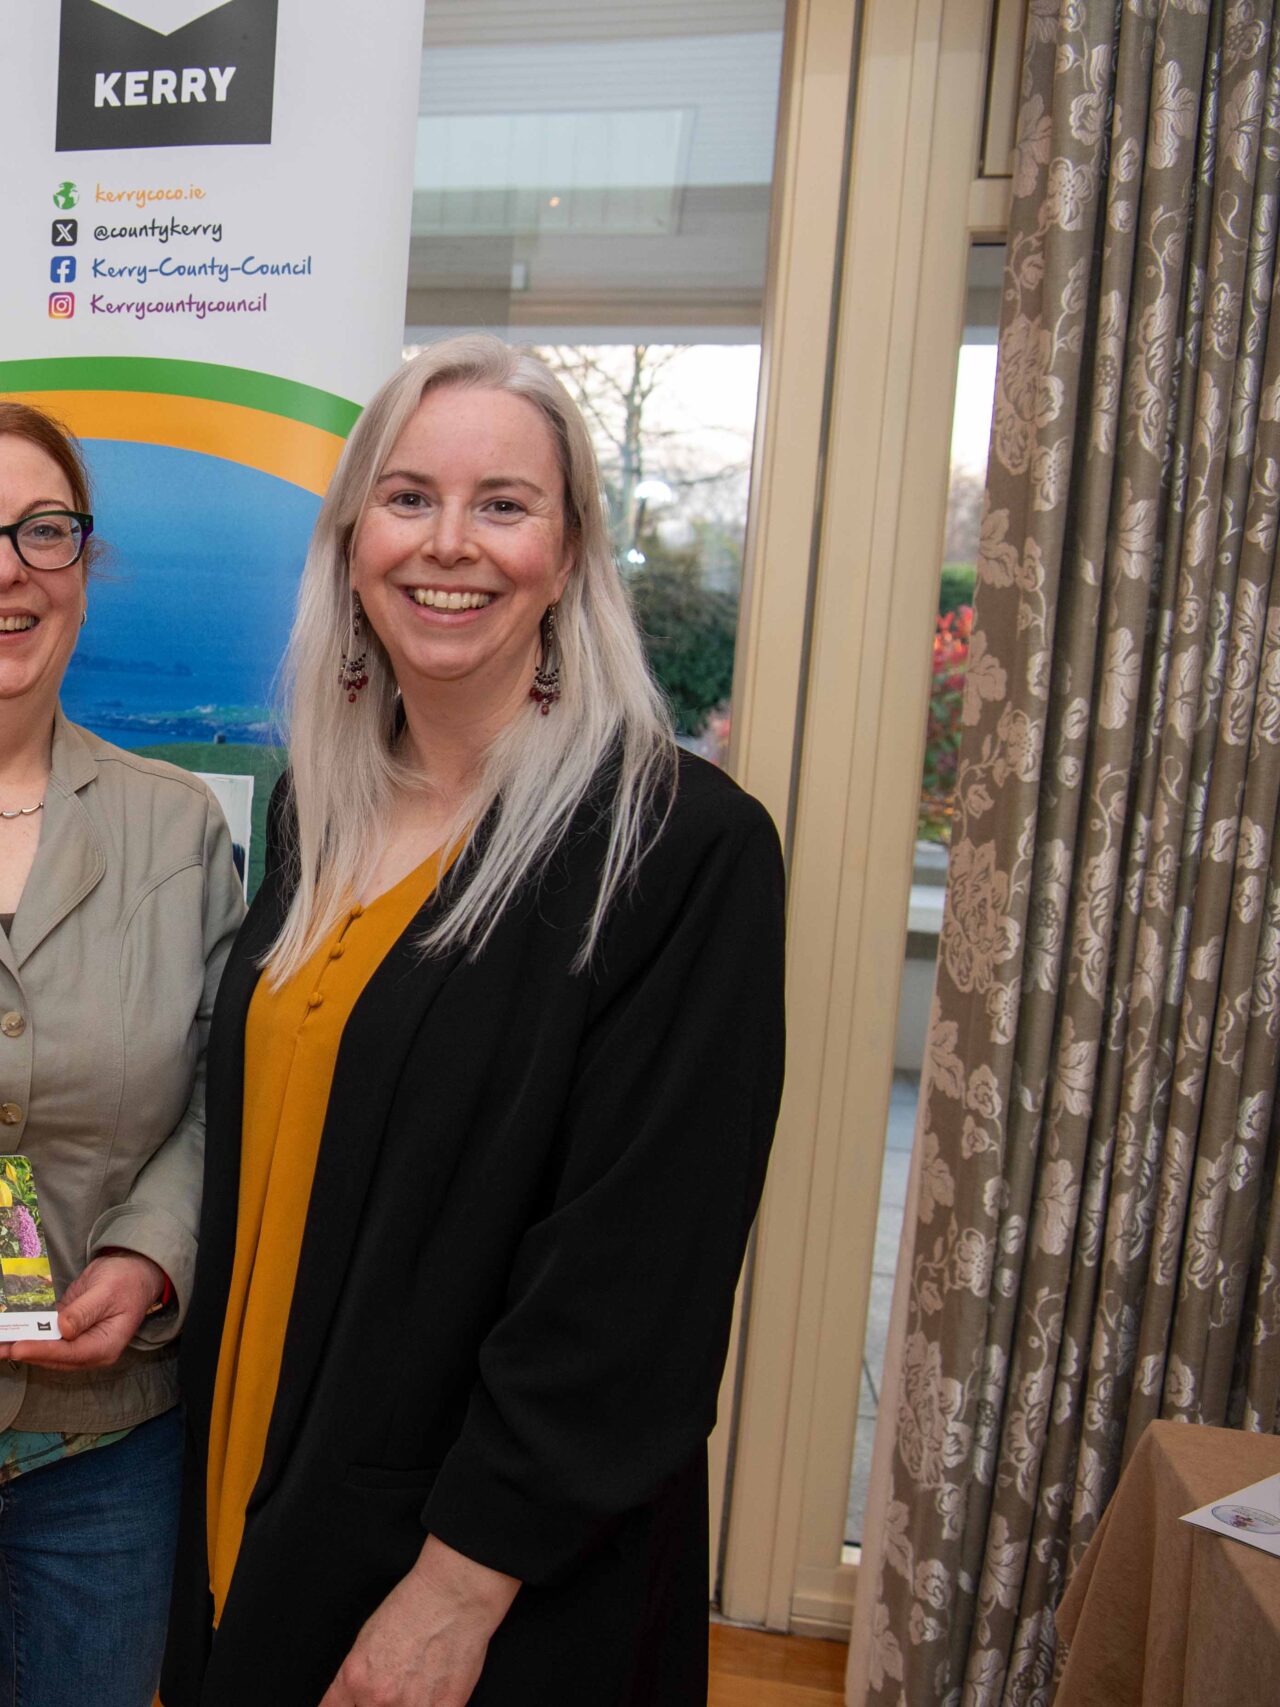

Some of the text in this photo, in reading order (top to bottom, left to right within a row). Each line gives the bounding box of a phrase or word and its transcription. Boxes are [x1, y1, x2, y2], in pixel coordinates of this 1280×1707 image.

[94, 66, 237, 107] KERRY
[95, 183, 206, 208] kerrycoco.ie
[93, 216, 223, 243] @countykerry
[92, 255, 312, 283] Kerry-County-Council
[90, 293, 268, 319] Kerrycountycouncil
